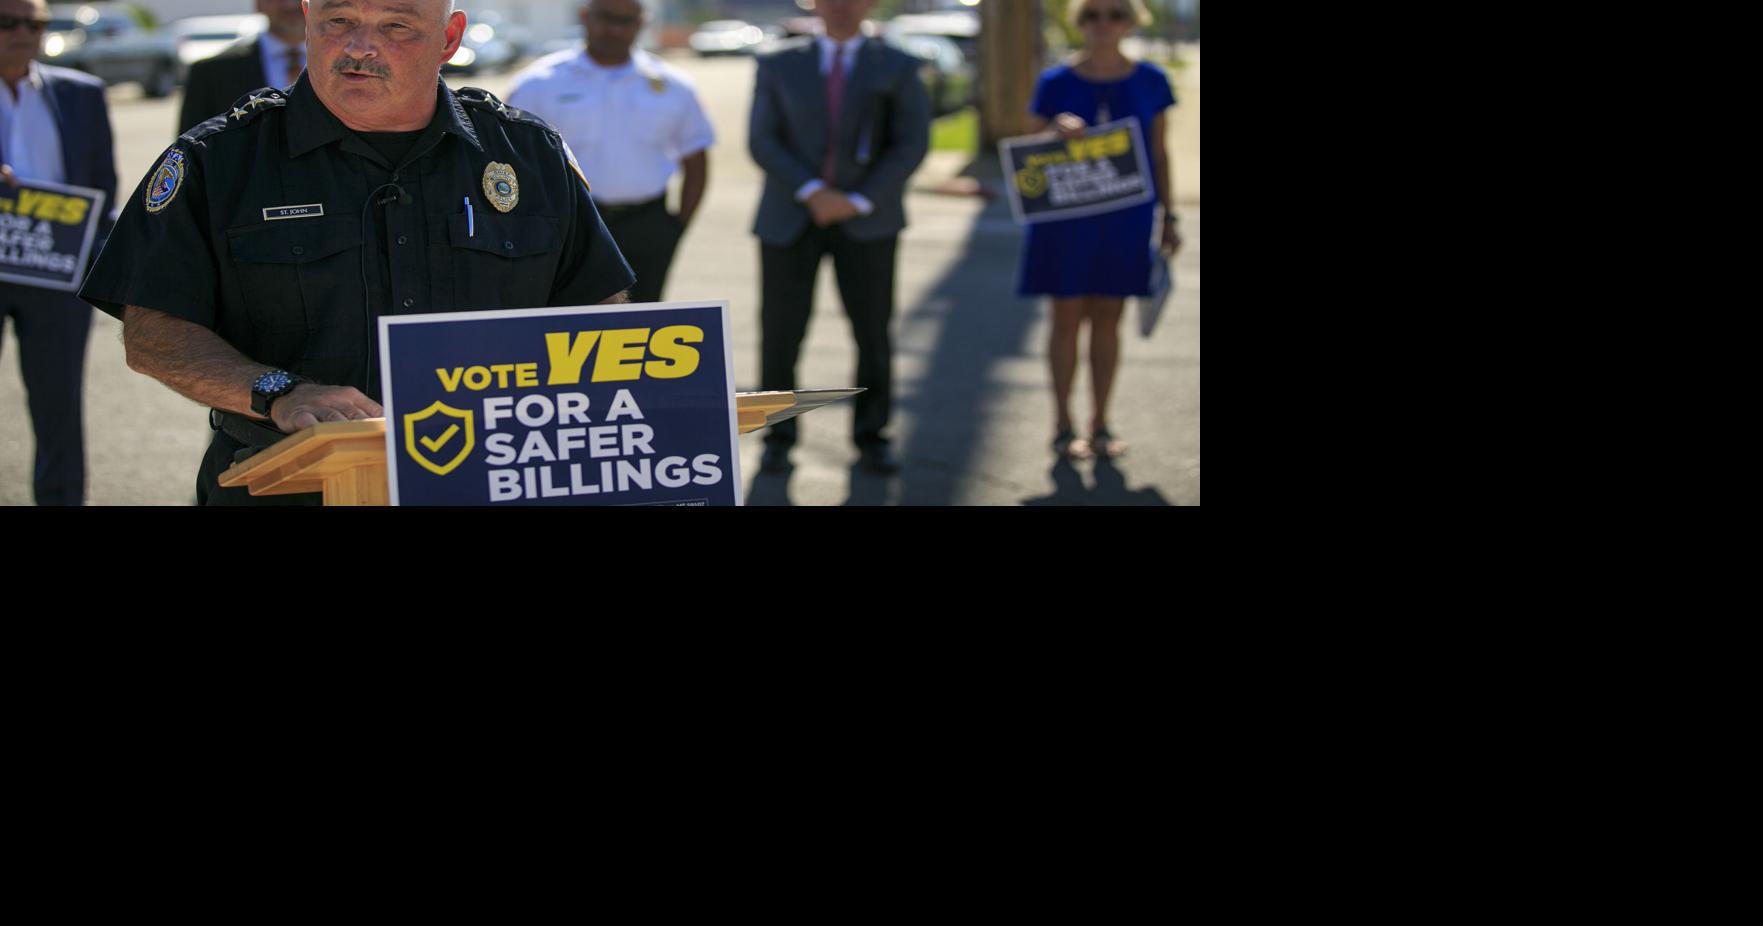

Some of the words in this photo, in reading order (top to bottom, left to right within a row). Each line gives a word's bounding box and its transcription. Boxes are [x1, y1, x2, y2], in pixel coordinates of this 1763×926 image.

[16, 189, 88, 225] YES
[289, 207, 308, 216] JOHN
[436, 363, 539, 393] VOTE
[545, 325, 705, 385] YES
[483, 393, 591, 430] FOR
[605, 389, 644, 422] A
[484, 424, 656, 466] SAFER
[488, 453, 723, 502] BILLINGS
